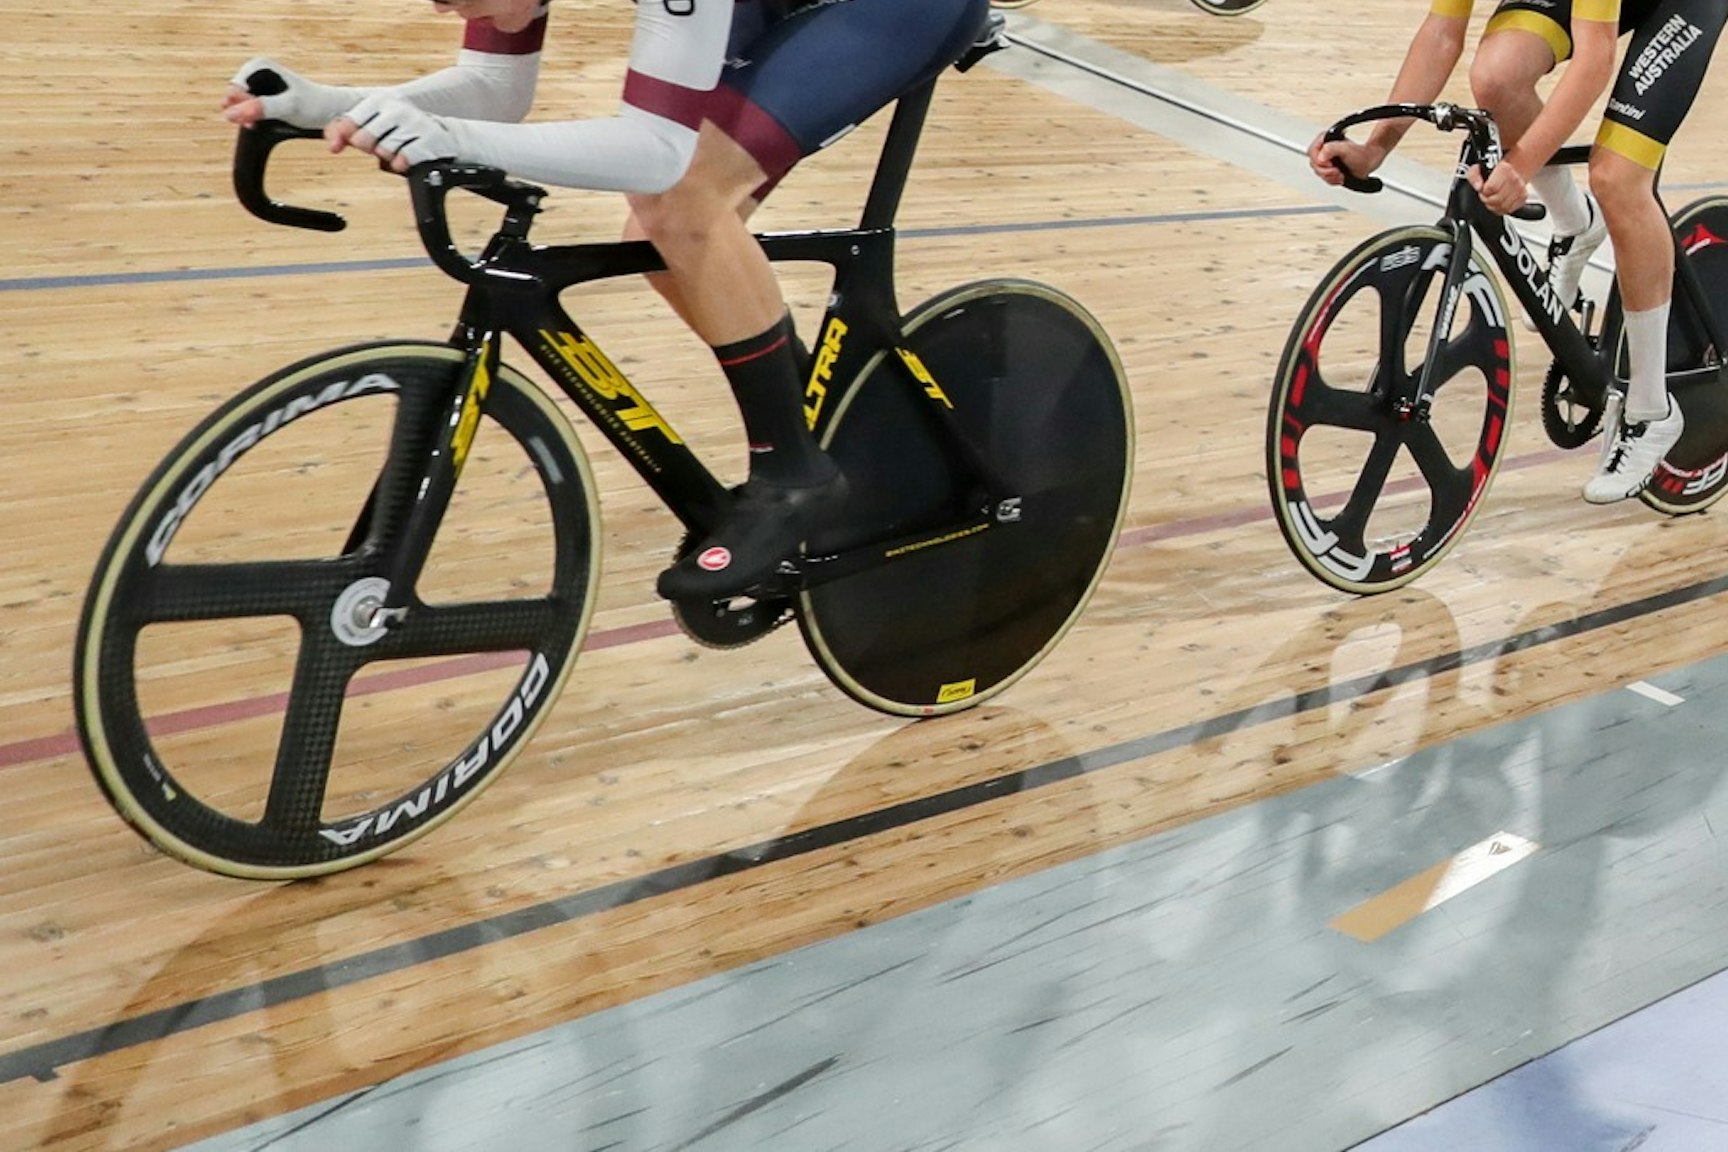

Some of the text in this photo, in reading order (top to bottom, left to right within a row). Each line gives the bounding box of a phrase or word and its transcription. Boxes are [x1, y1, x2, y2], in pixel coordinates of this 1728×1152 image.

[1628, 13, 1688, 81] WESTERN
[1633, 23, 1703, 97] AUSTRALIA
[145, 372, 401, 569] CORIMA
[318, 651, 551, 847] CORIMA
